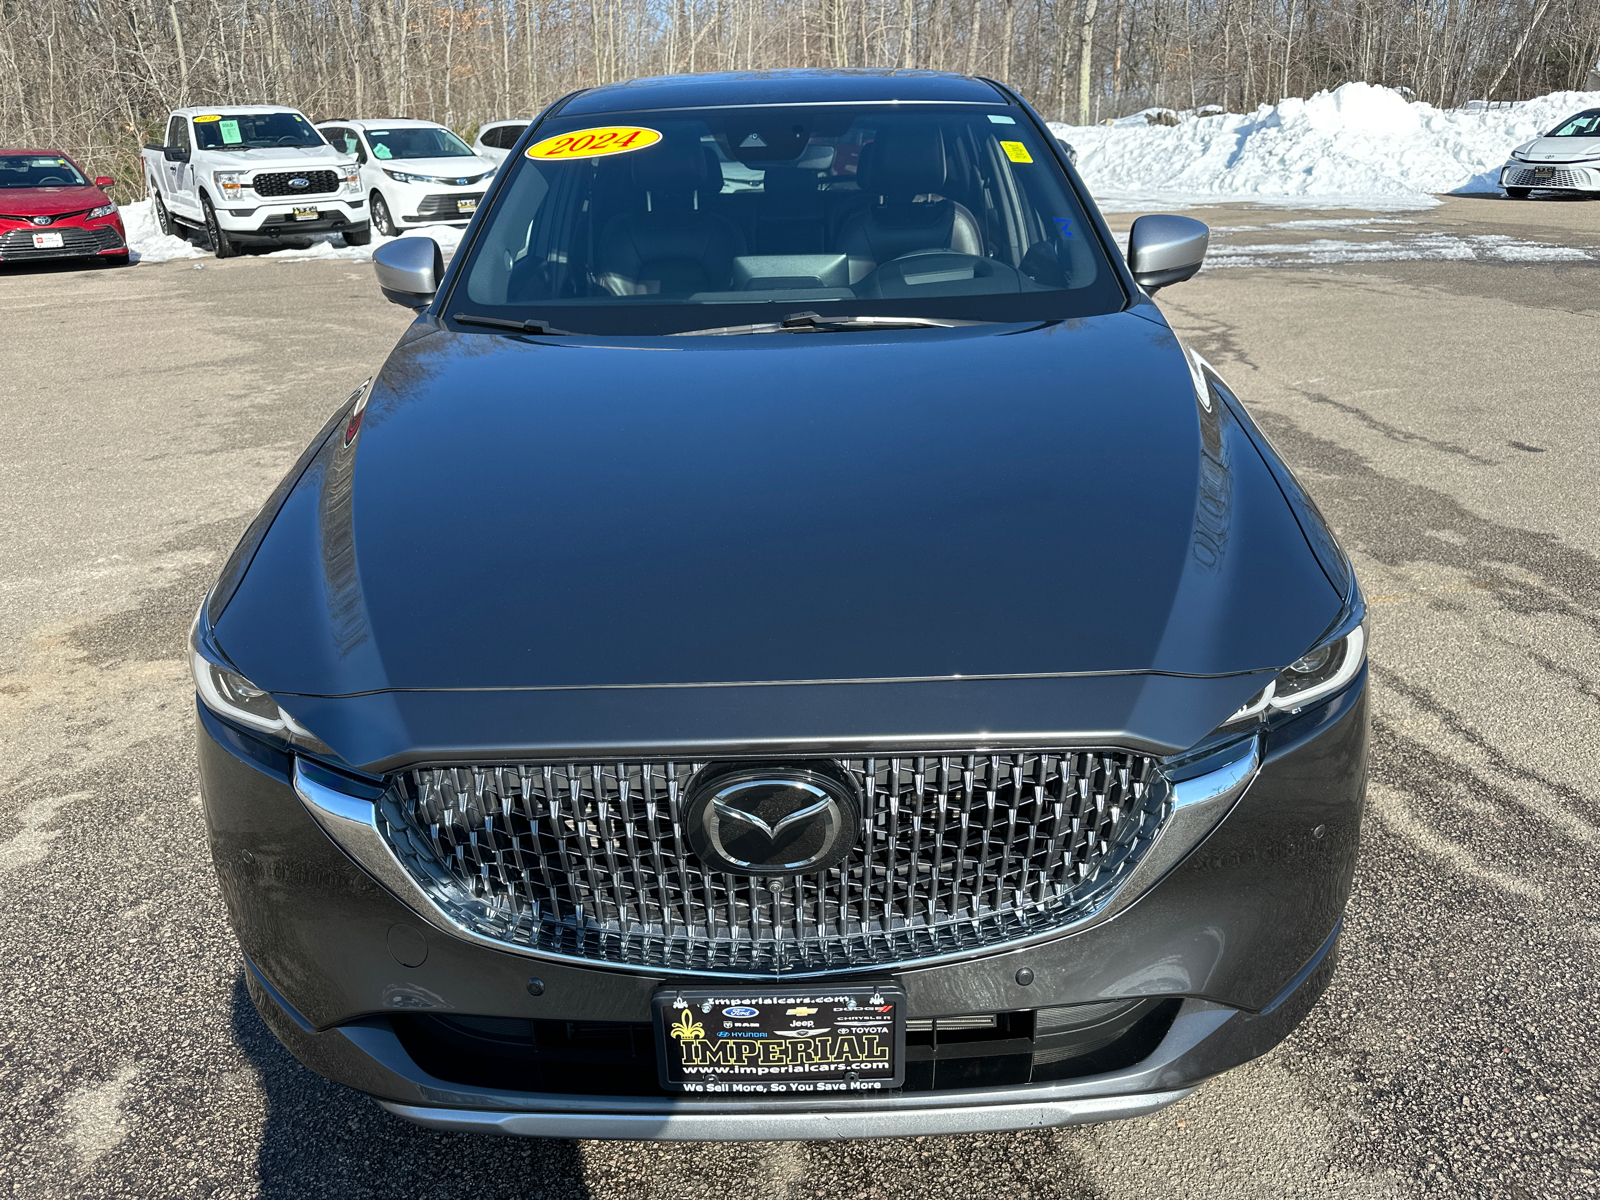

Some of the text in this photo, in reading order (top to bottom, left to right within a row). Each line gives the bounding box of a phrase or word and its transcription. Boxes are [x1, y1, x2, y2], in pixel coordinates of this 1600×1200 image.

[544, 130, 642, 156] 2024
[730, 1008, 751, 1016] Ford
[680, 1035, 889, 1066] IMPERIAL
[682, 1061, 890, 1076] www.imperialcars.com
[683, 1081, 882, 1093] We Sell More, So You Save More
